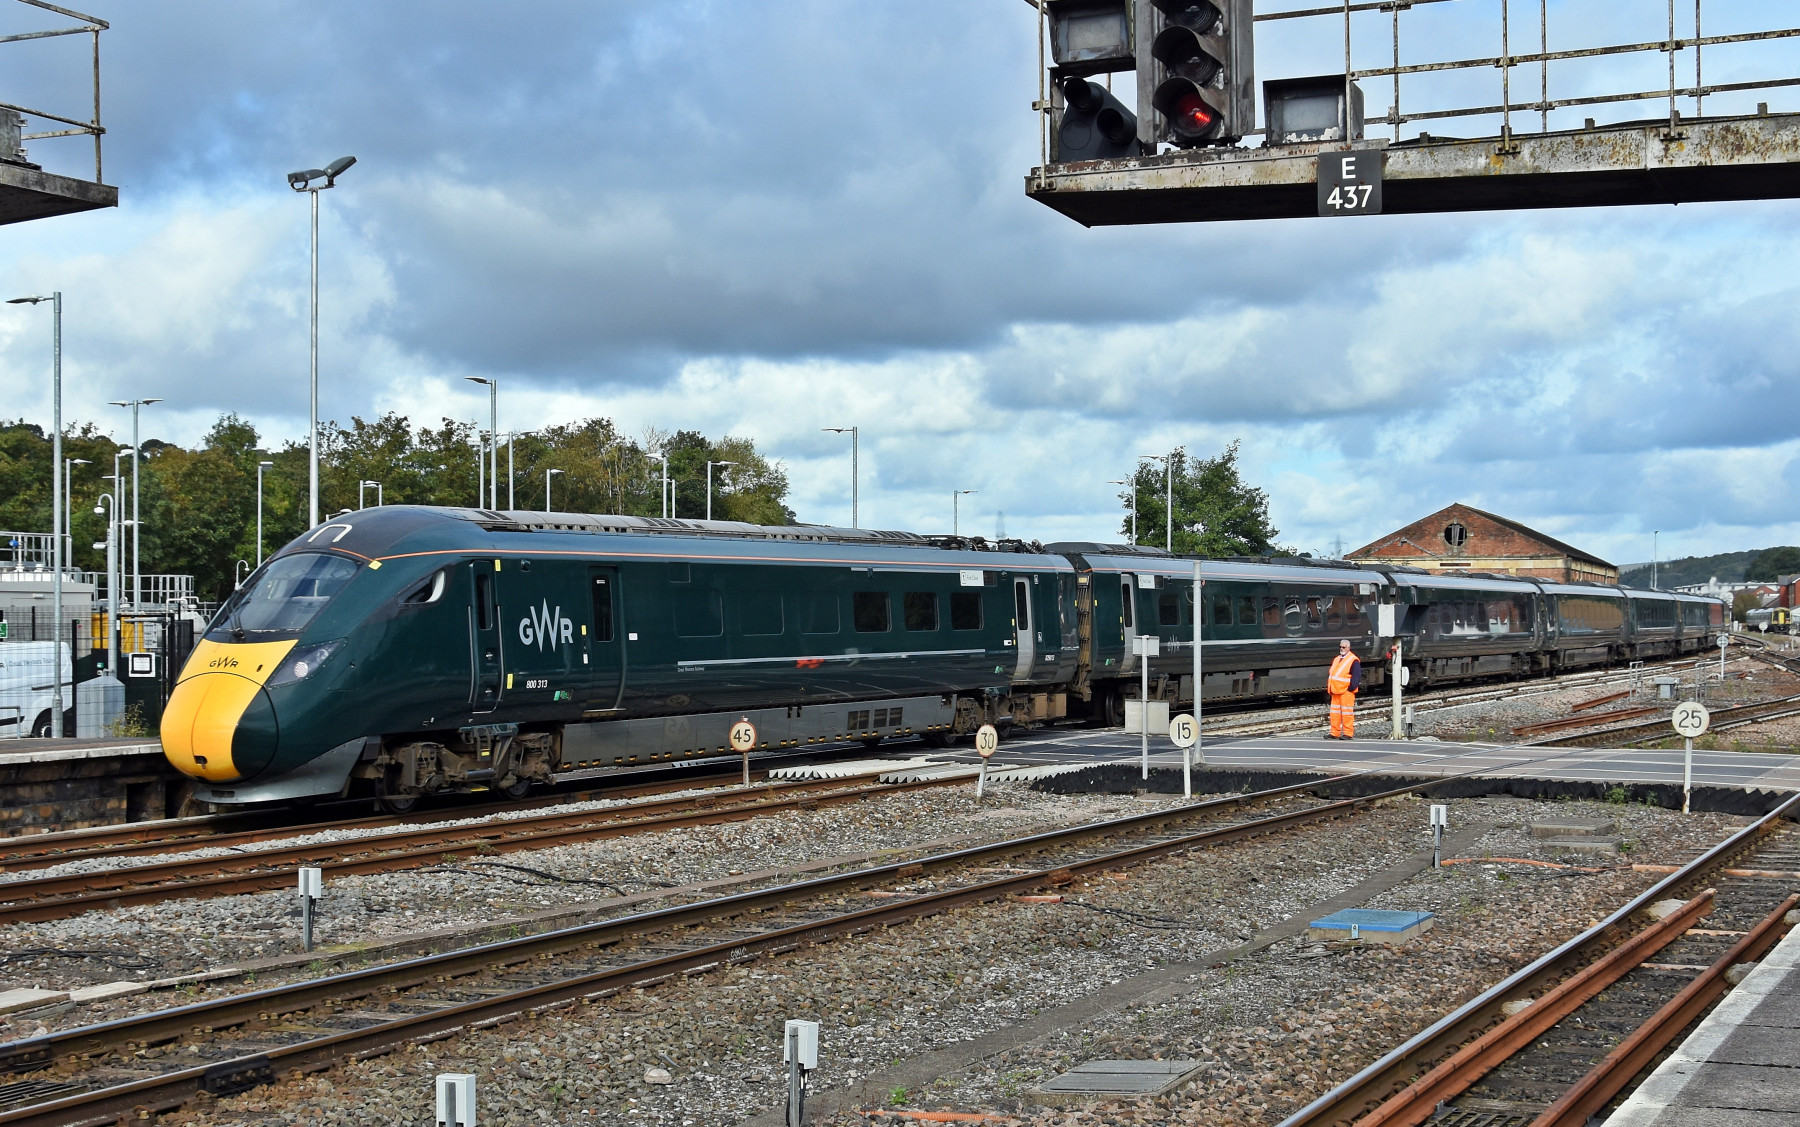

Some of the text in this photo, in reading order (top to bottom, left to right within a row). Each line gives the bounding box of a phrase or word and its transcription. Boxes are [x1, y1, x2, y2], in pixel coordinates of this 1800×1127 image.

[1342, 157, 1356, 179] E
[1326, 185, 1373, 210] 437
[519, 597, 574, 653] GWR
[209, 656, 239, 668] GWR
[526, 679, 548, 689] 800 313
[1678, 709, 1702, 729] 25
[733, 729, 751, 743] 45
[1177, 722, 1191, 740] 15
[980, 732, 995, 750] 30
